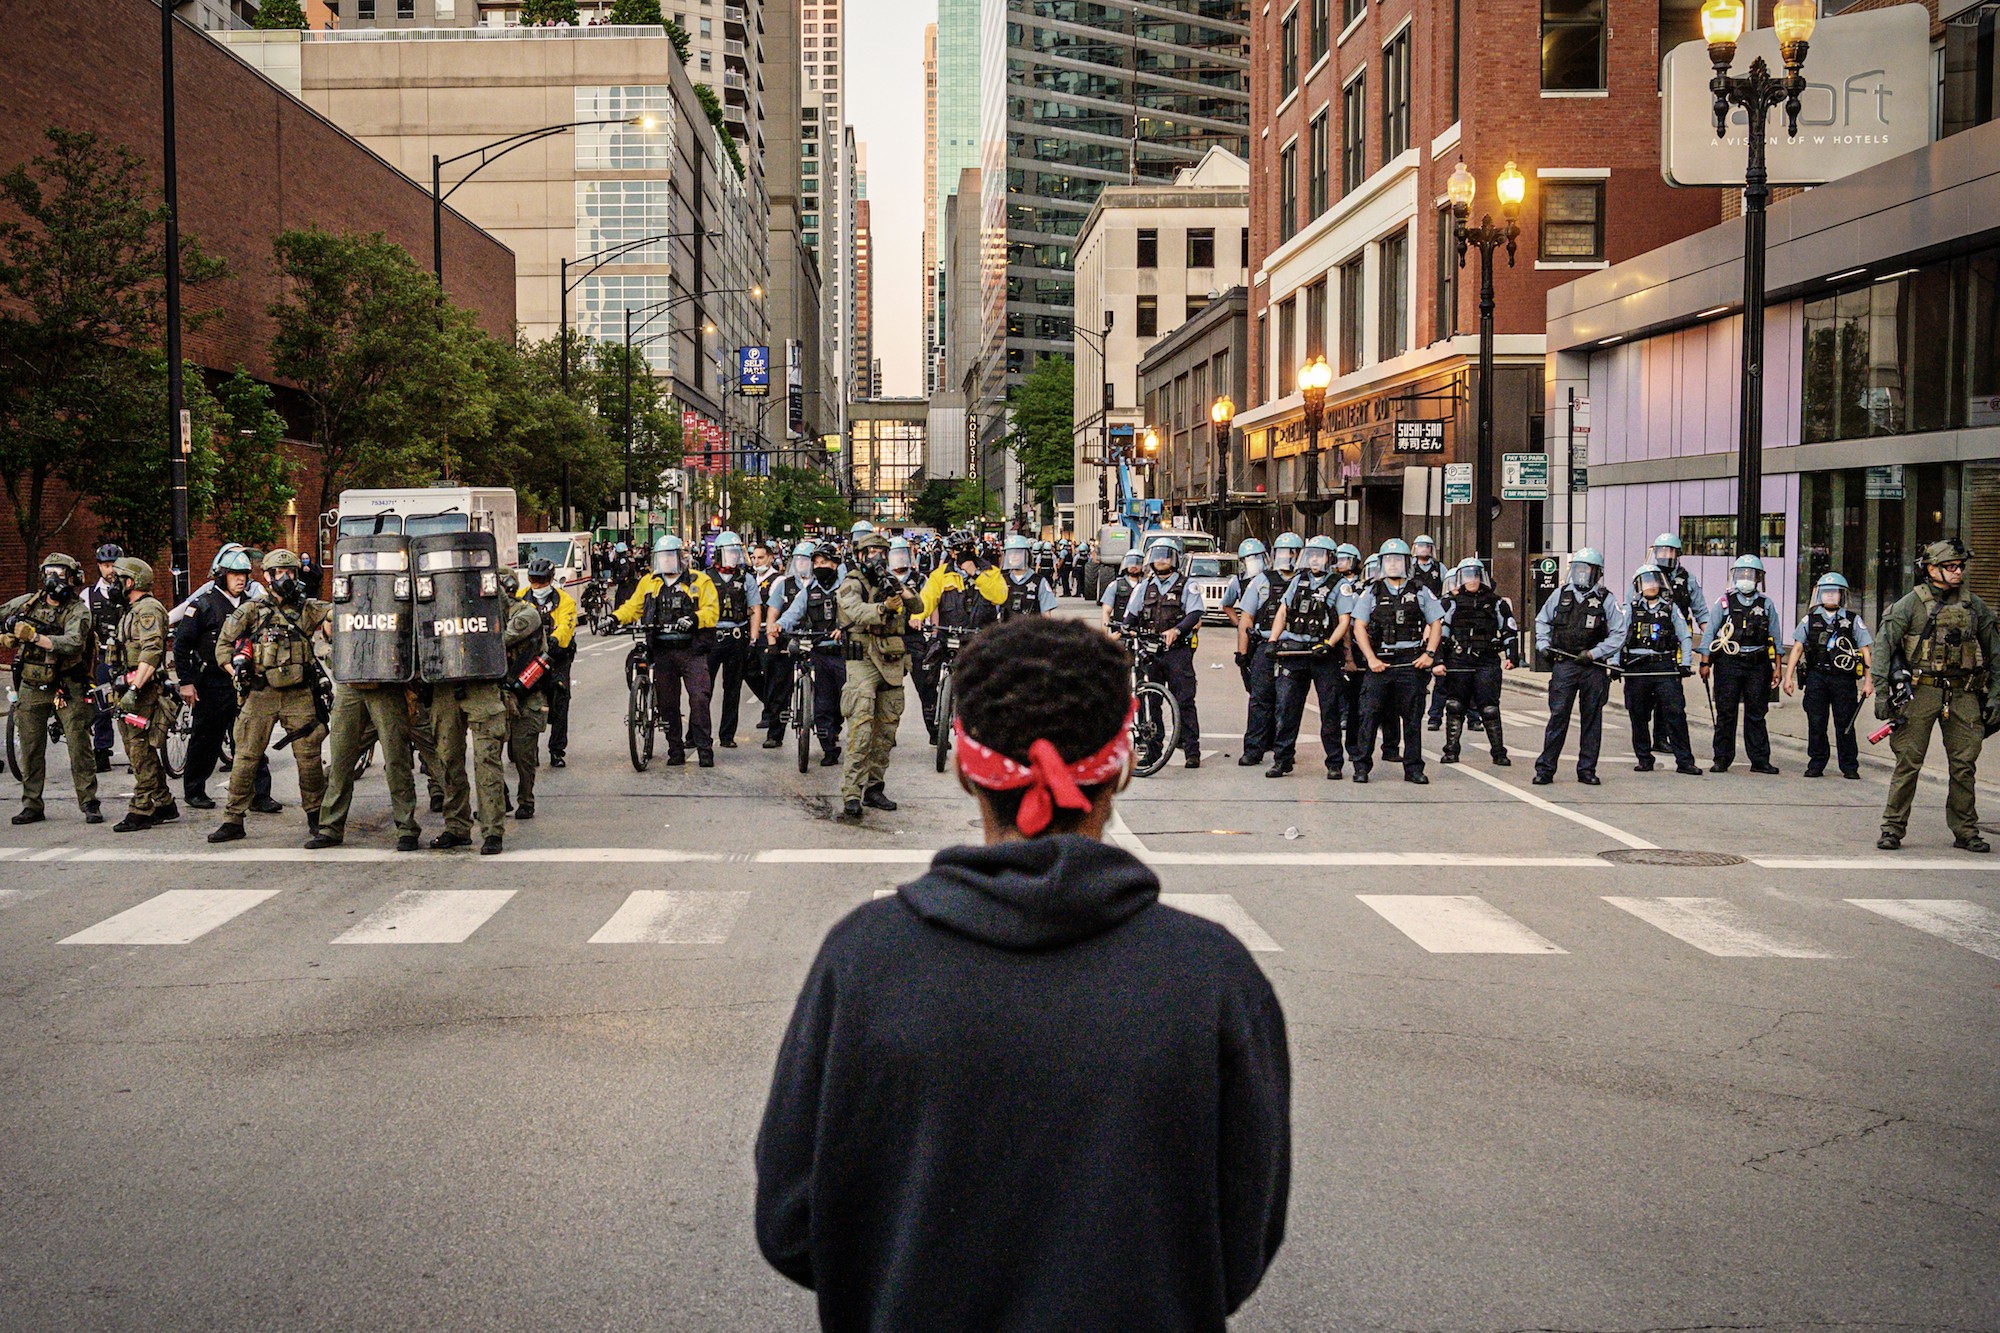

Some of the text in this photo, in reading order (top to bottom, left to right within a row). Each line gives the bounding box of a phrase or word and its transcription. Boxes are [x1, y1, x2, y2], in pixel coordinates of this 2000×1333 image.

[1711, 65, 1893, 128] loft
[1710, 134, 1889, 146] A VISN OF W HOTELS
[744, 359, 765, 367] SELF
[743, 367, 766, 375] PARK
[1397, 423, 1443, 437] SUSHI-SAN
[1397, 437, 1442, 450] 寿司さん
[345, 613, 397, 631] POLICE
[433, 616, 489, 636] POLICE
